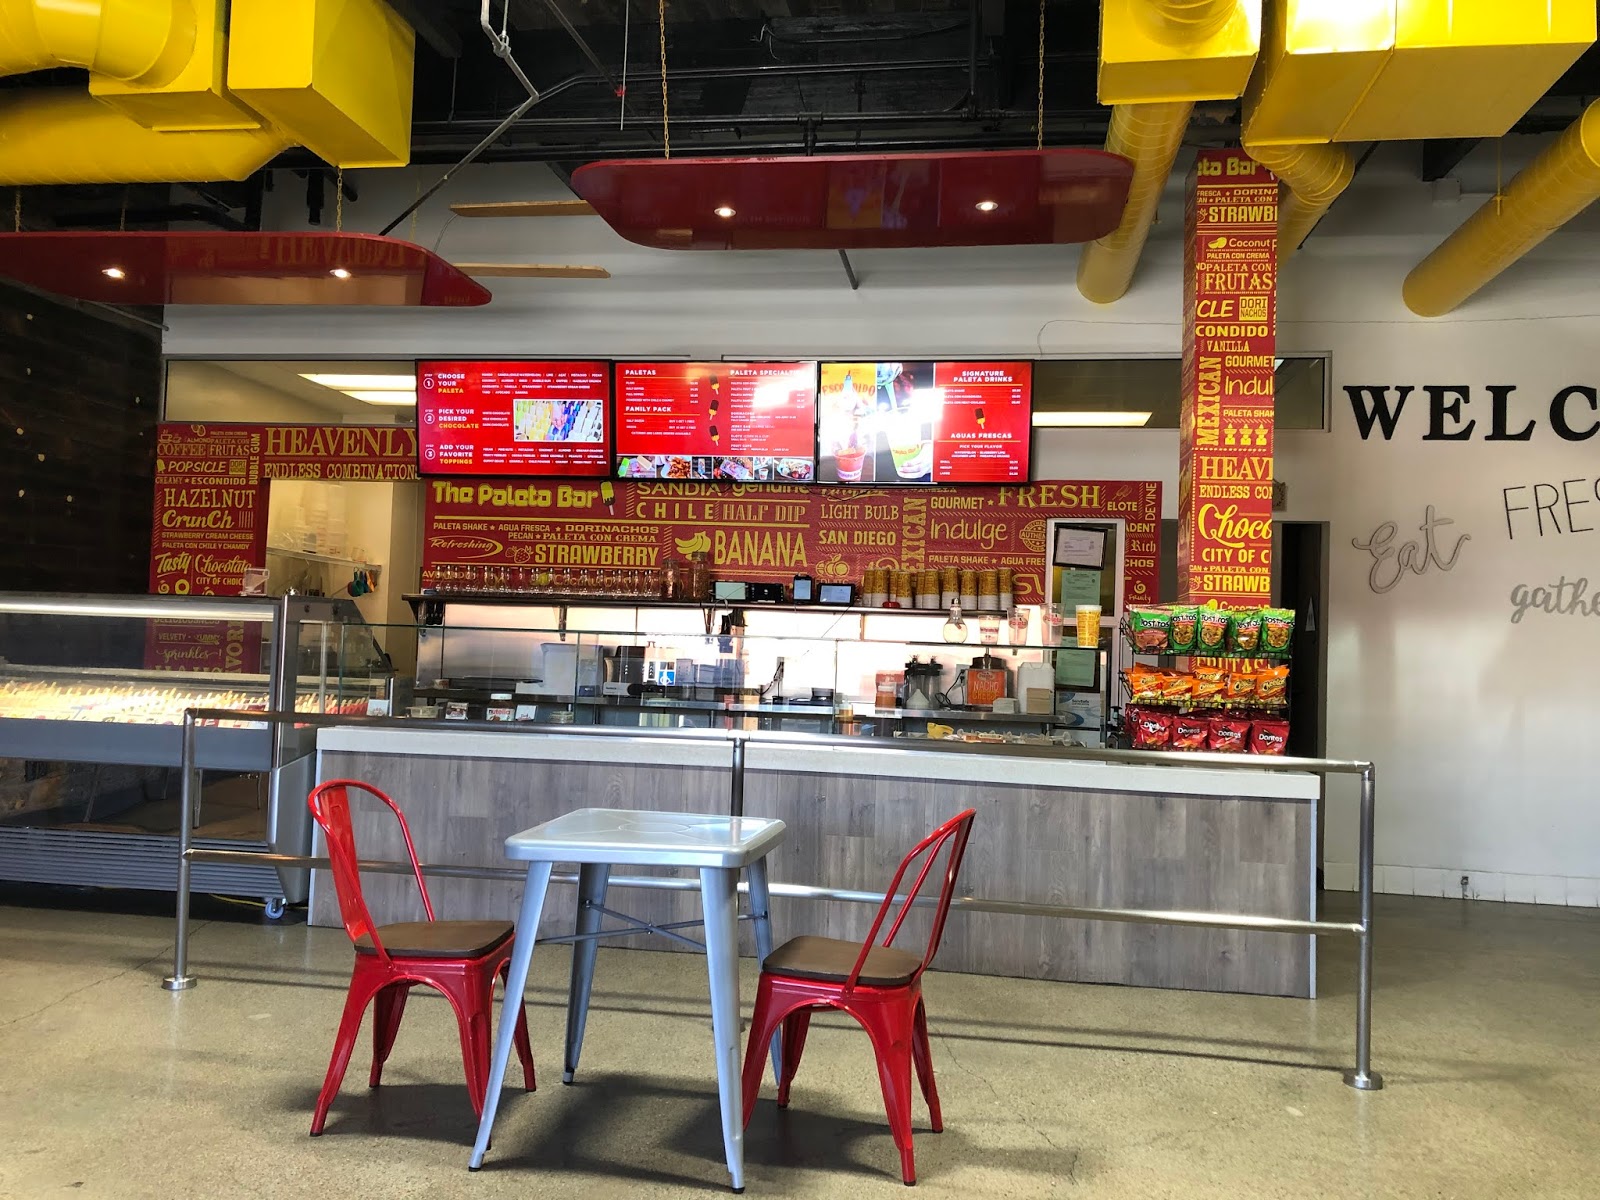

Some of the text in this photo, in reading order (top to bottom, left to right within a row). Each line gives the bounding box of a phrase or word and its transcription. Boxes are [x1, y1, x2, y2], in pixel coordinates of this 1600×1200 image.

[1226, 157, 1260, 176] Bar
[1228, 238, 1270, 248] Coconut
[1206, 263, 1272, 272] PALETA CON
[1205, 273, 1273, 291] FRUTAS
[1240, 298, 1267, 308] DORI
[1240, 308, 1267, 318] NACHOS
[1195, 325, 1269, 337] CONDIDO
[1206, 340, 1250, 352] VANILLA
[1224, 355, 1275, 367] GOURMET
[1224, 375, 1274, 396] Indul
[1196, 356, 1222, 446] MEXICAN
[1342, 385, 1600, 441] WELC
[157, 443, 206, 456] COFFEE
[209, 444, 250, 456] FRUTAS
[248, 433, 261, 485] BUBBLE GUM
[168, 461, 227, 473] POPSICLE
[264, 463, 321, 479] ENDLESS
[191, 477, 247, 485] ESCONDIDO
[432, 480, 599, 509] The Paleta Bar
[636, 482, 723, 497] SANDIA
[998, 484, 1102, 509] FRESH
[1199, 485, 1273, 499] ENDLESS CO
[163, 488, 256, 509] HAZELNUT
[930, 496, 984, 510] GOURMET
[1144, 482, 1157, 521] DEVINE
[635, 501, 714, 520] CHILE
[722, 503, 806, 523] HALF DIP
[820, 504, 899, 521] LIGHT BULB
[1106, 501, 1138, 512] ELOTE
[1502, 477, 1600, 540] FRE
[162, 531, 205, 539] STRAWBERRY
[433, 522, 659, 534] PALETA SHAKE AGUA FRESCA DORINACHOS
[901, 498, 927, 573] EXICAN
[930, 518, 1008, 550] Indulge
[508, 531, 656, 543] PECAN PALETA CON CREMA
[818, 529, 896, 546] SAN DIEGO
[430, 538, 494, 552] Refreshing
[714, 529, 808, 567] BANANA
[1131, 539, 1156, 553] Rich
[1351, 504, 1472, 594] Eat
[534, 543, 659, 566] STRAWBERRY
[928, 555, 960, 564] PALETA
[960, 556, 989, 565] SHAKE
[1000, 556, 1024, 565] AGUA
[1202, 548, 1233, 562] CITY
[1238, 549, 1255, 563] OF
[154, 551, 192, 575] Tasty
[195, 576, 244, 586] CITY OF CHOIC
[158, 633, 187, 641] VELVETY
[156, 646, 218, 663] sprinkles
[973, 681, 999, 691] NACHO
[1258, 733, 1283, 743] Doritos
